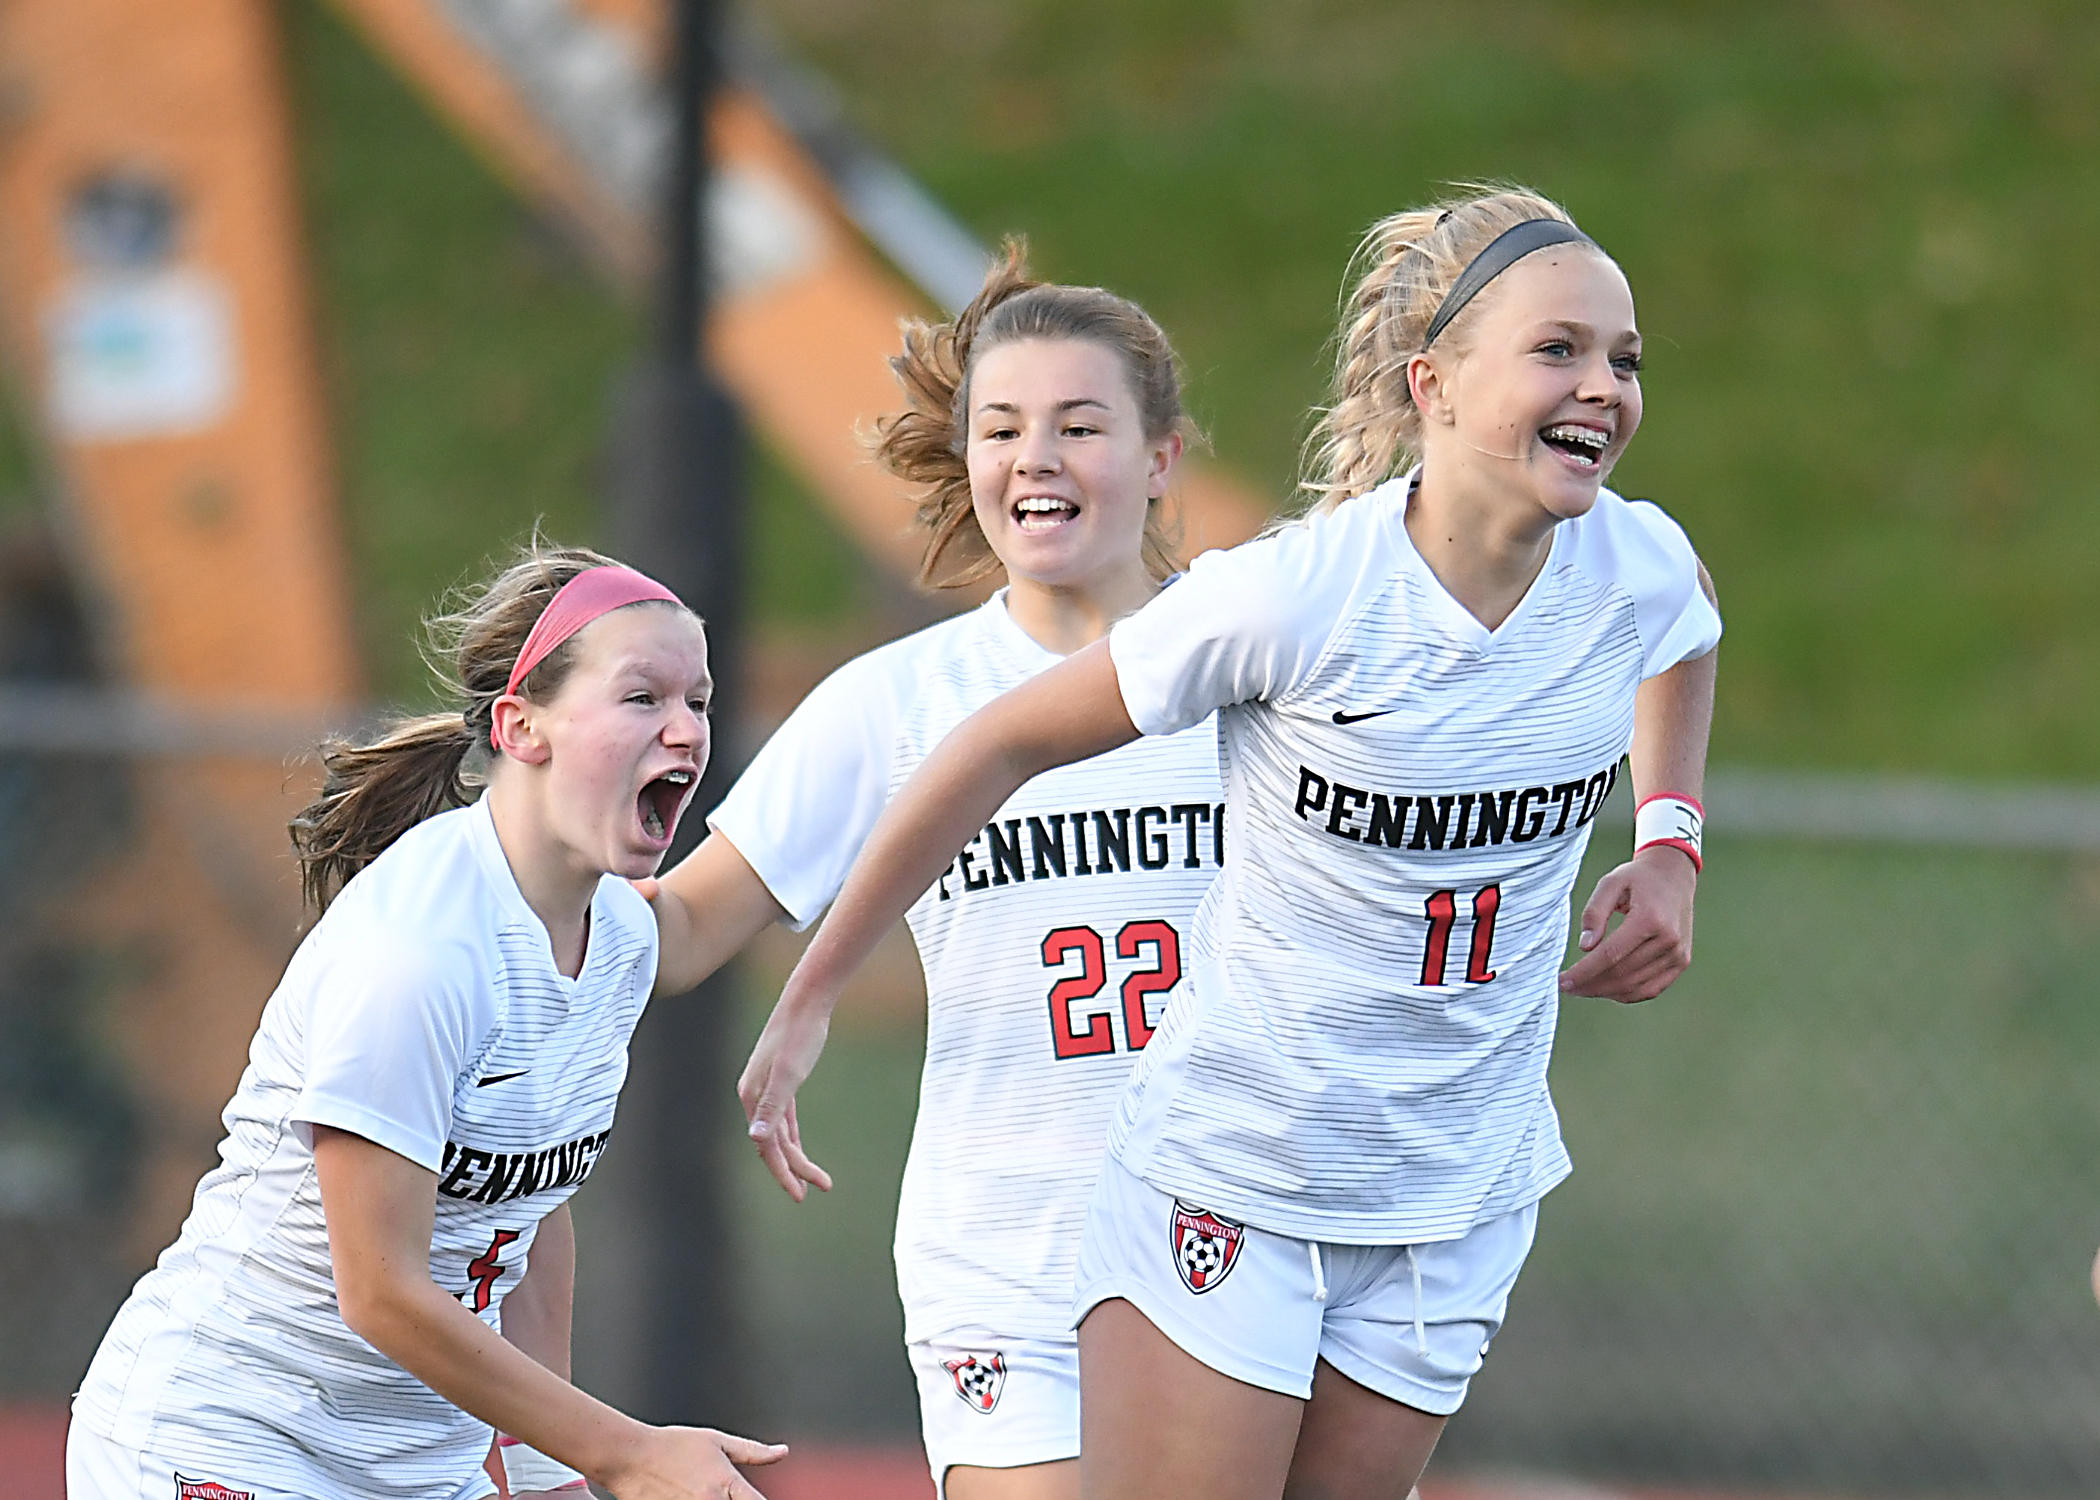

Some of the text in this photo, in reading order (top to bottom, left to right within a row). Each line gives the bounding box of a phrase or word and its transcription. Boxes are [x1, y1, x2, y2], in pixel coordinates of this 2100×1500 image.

[1413, 884, 1500, 986] 11
[1040, 919, 1182, 1061] 22
[1176, 1213, 1239, 1241] PENNINGTON
[182, 1484, 248, 1500] PENNINGTON
